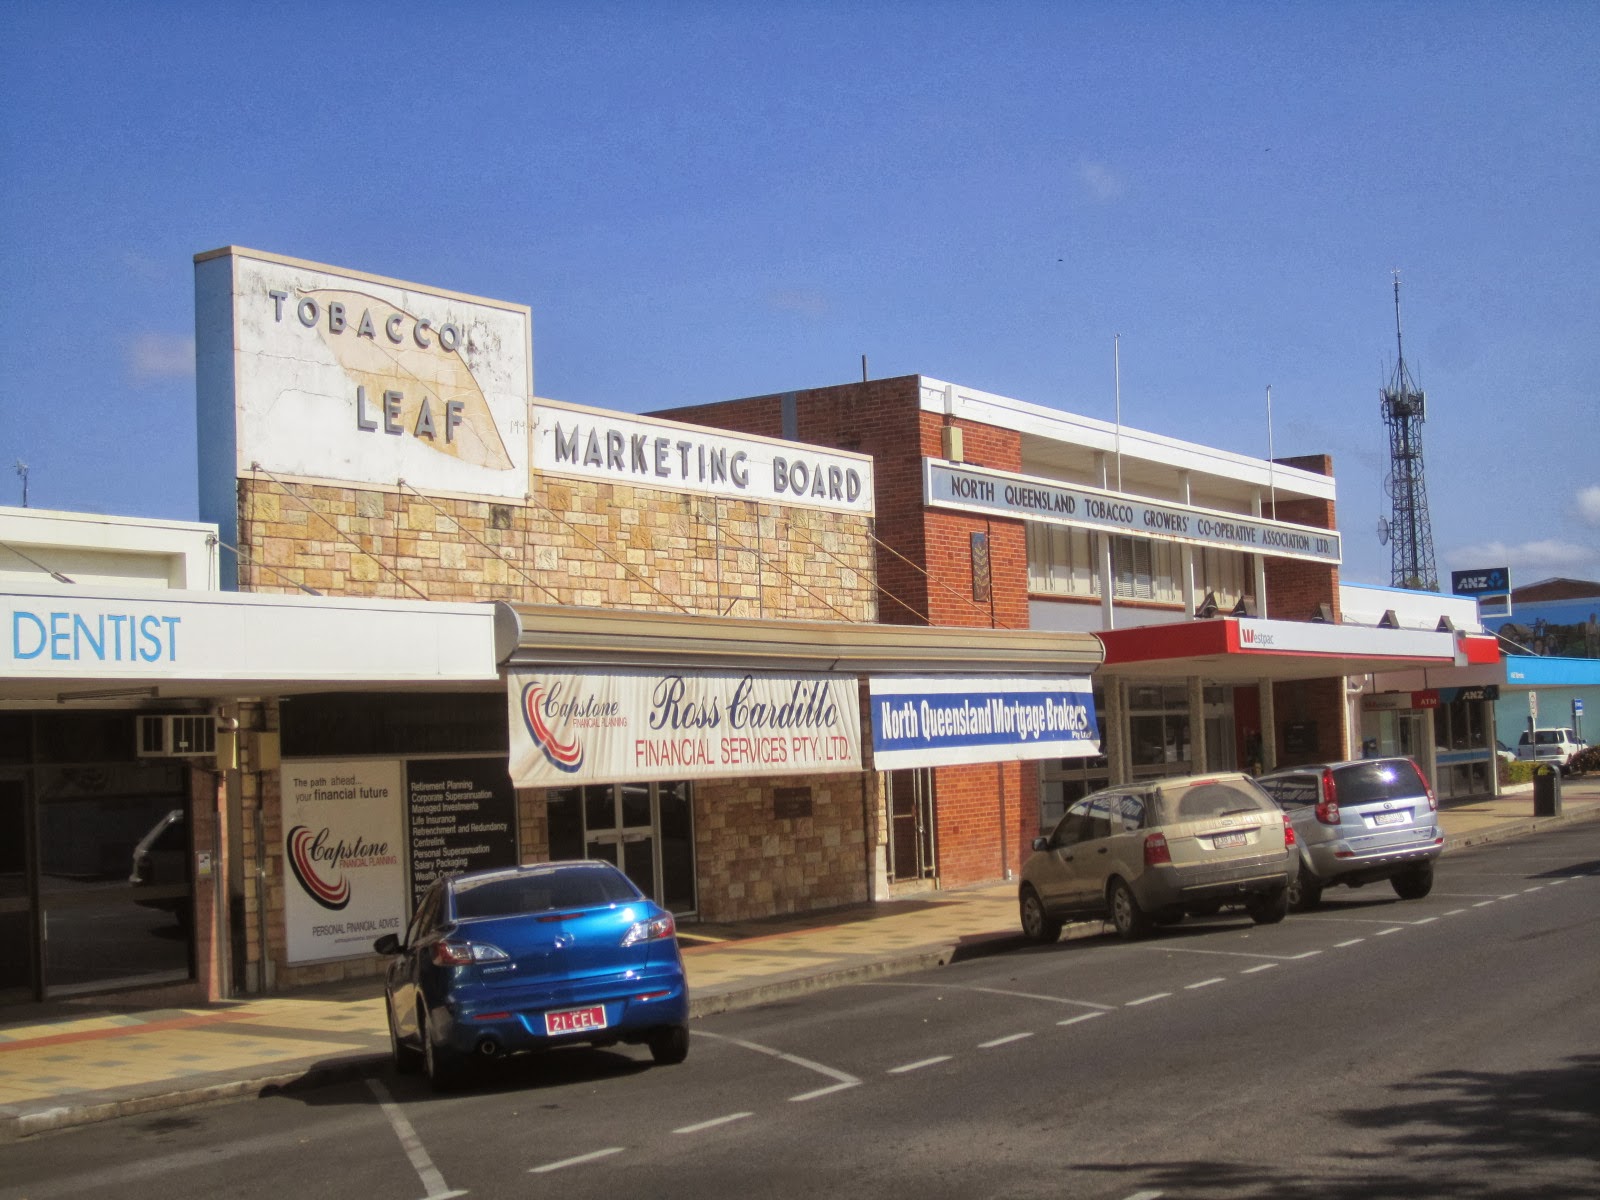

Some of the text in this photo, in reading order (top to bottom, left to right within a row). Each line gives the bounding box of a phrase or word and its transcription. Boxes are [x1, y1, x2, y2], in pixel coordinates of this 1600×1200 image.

[269, 290, 461, 351] TOBACCO
[357, 385, 464, 444] LEAF
[555, 421, 862, 503] MARKETING BOARD
[951, 475, 994, 502] NORTH
[1004, 485, 1076, 514] QUEENSLAND
[1084, 498, 1134, 524] TOBACCO
[1143, 510, 1190, 533] GROWERS'
[1197, 519, 1256, 543] CO-OPERATIVE
[1262, 531, 1310, 551] ASSOCIATION
[1457, 576, 1488, 590] ANZ
[13, 611, 181, 662] DENTIST
[1241, 628, 1274, 647] Westpac
[541, 681, 620, 727] Capstone
[649, 674, 838, 730] Ross Cardillo
[572, 717, 627, 728] FINANCIAL PLANNING
[881, 697, 1087, 741] North Queensland Mortgage Brokers
[635, 736, 852, 767] FINANCIAL SERVICES PTY. LTD.
[294, 778, 308, 787] The
[310, 778, 327, 788] path
[411, 780, 473, 792] Retirement Planning
[296, 786, 388, 803] your financial future
[411, 791, 492, 804] Corporate Superannuation
[412, 802, 479, 815] Managed Investments
[426, 815, 456, 824] Insurance
[413, 822, 507, 836] Retrenchment and Redundancy
[307, 827, 388, 869] Capstone
[413, 838, 446, 849] Centrelink
[413, 845, 490, 859] Personal Superannuation
[414, 857, 469, 871] Salary Packaging
[312, 917, 400, 937] PERSONAL FINANCIAL ADVICE
